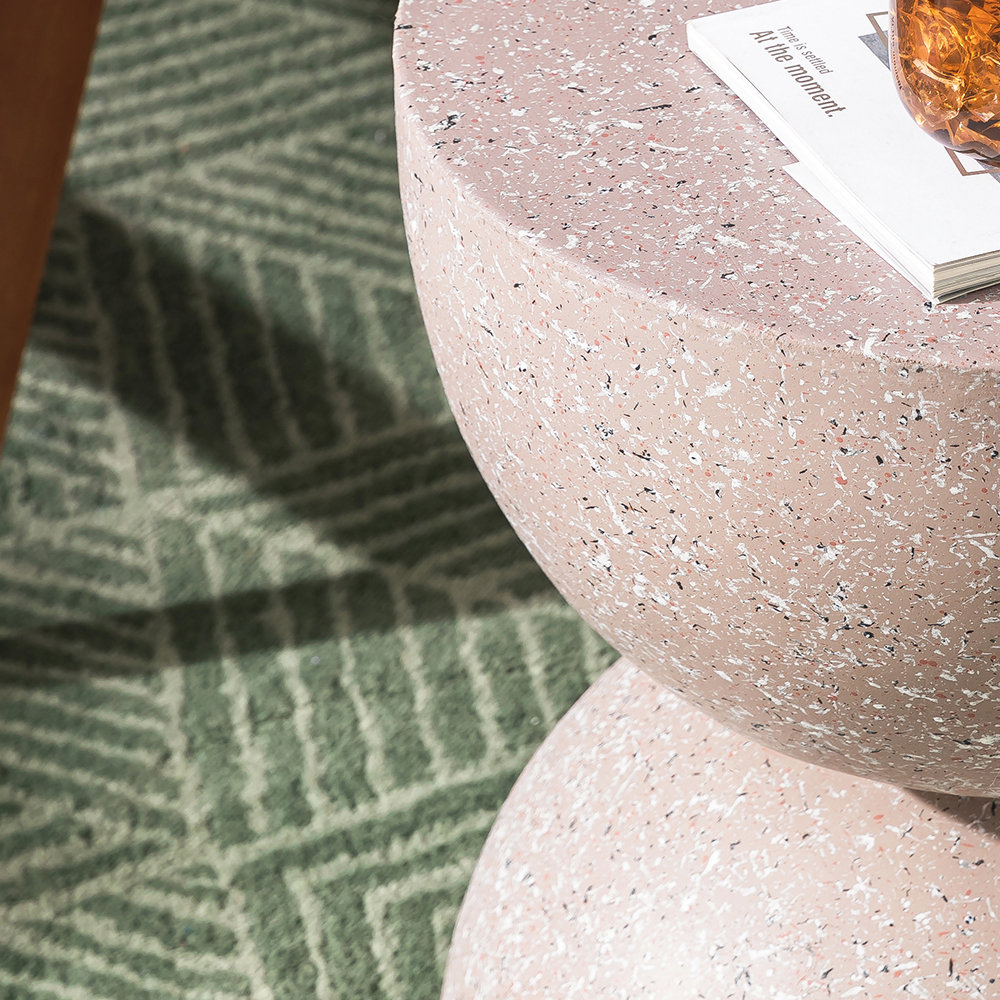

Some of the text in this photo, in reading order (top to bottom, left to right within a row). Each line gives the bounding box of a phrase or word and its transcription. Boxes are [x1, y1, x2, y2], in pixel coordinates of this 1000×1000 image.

[749, 30, 847, 118] At the moment.
[777, 26, 834, 75] Time is settled
